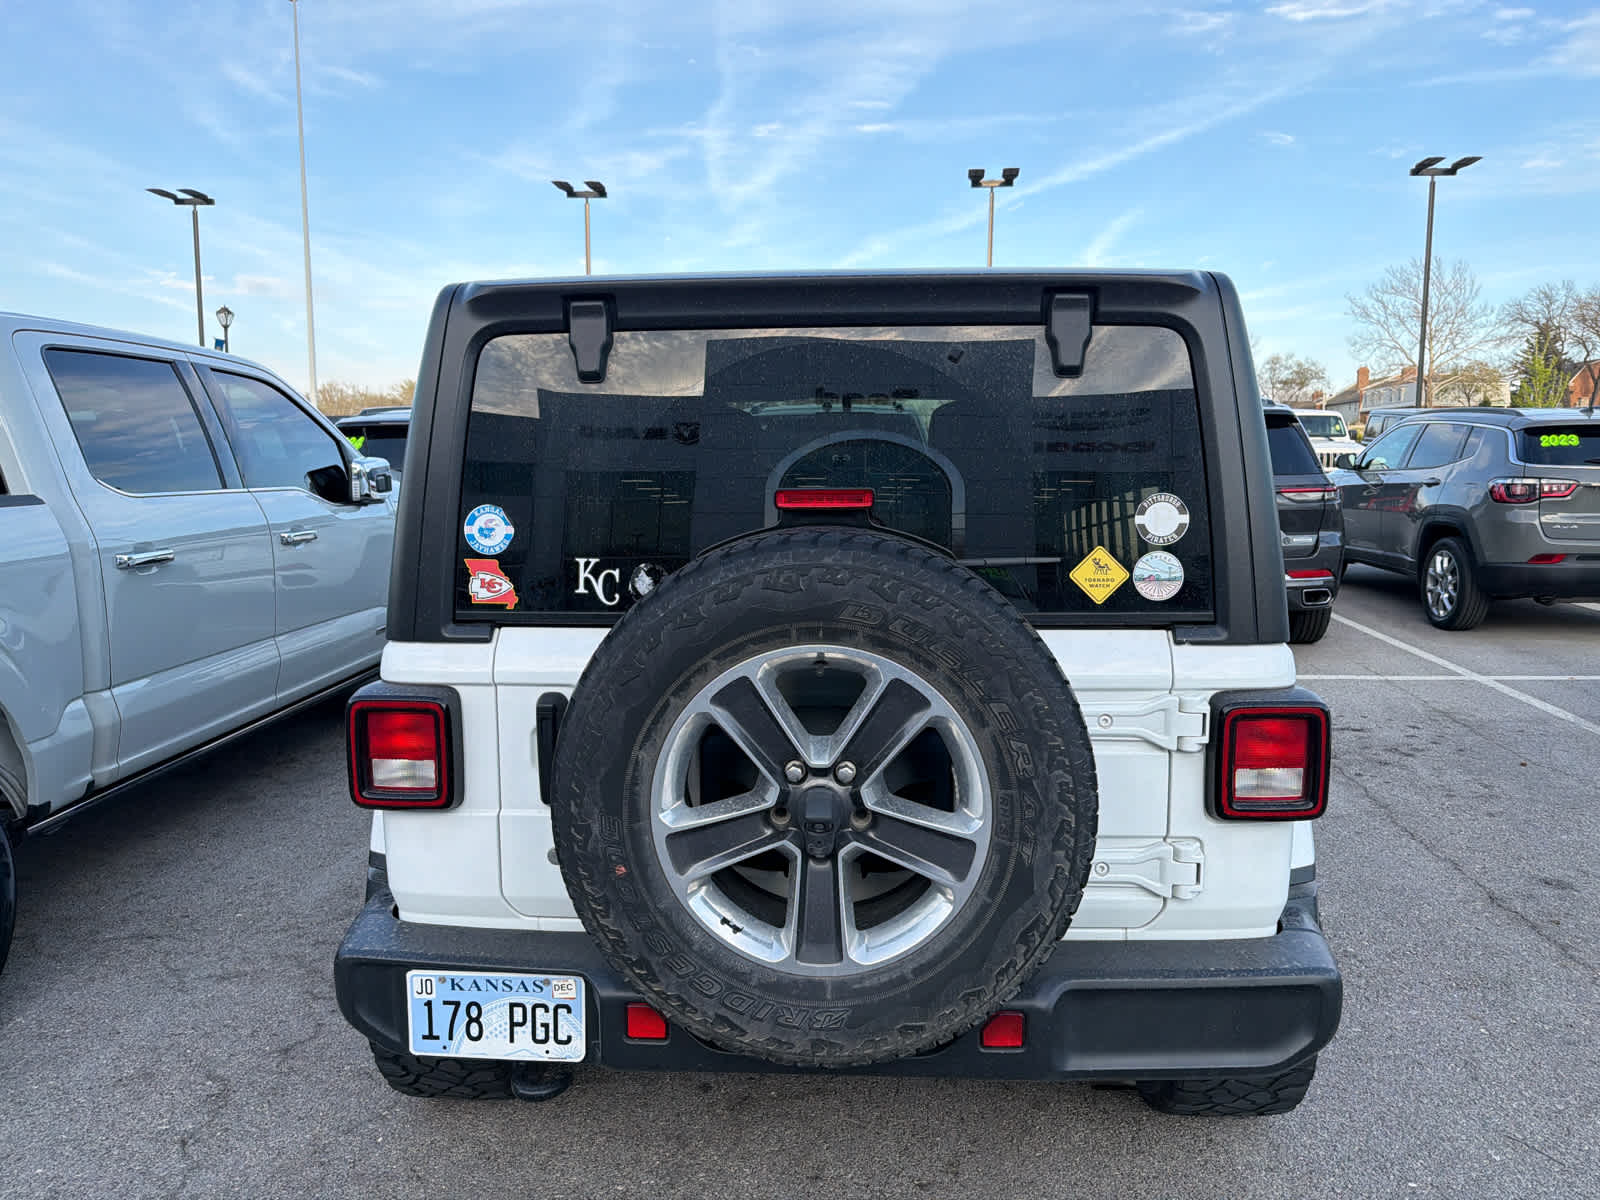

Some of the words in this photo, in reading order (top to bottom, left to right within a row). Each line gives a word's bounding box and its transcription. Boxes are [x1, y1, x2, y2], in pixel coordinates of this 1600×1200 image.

[1540, 434, 1579, 447] 2023
[1144, 494, 1181, 507] PITTSBURGH
[1146, 534, 1178, 544] PIRATES
[479, 578, 503, 593] KC
[574, 558, 620, 605] KC
[450, 978, 544, 993] KANSAS
[553, 983, 573, 992] DEC
[422, 1000, 484, 1042] 178
[508, 1002, 572, 1045] PGC
